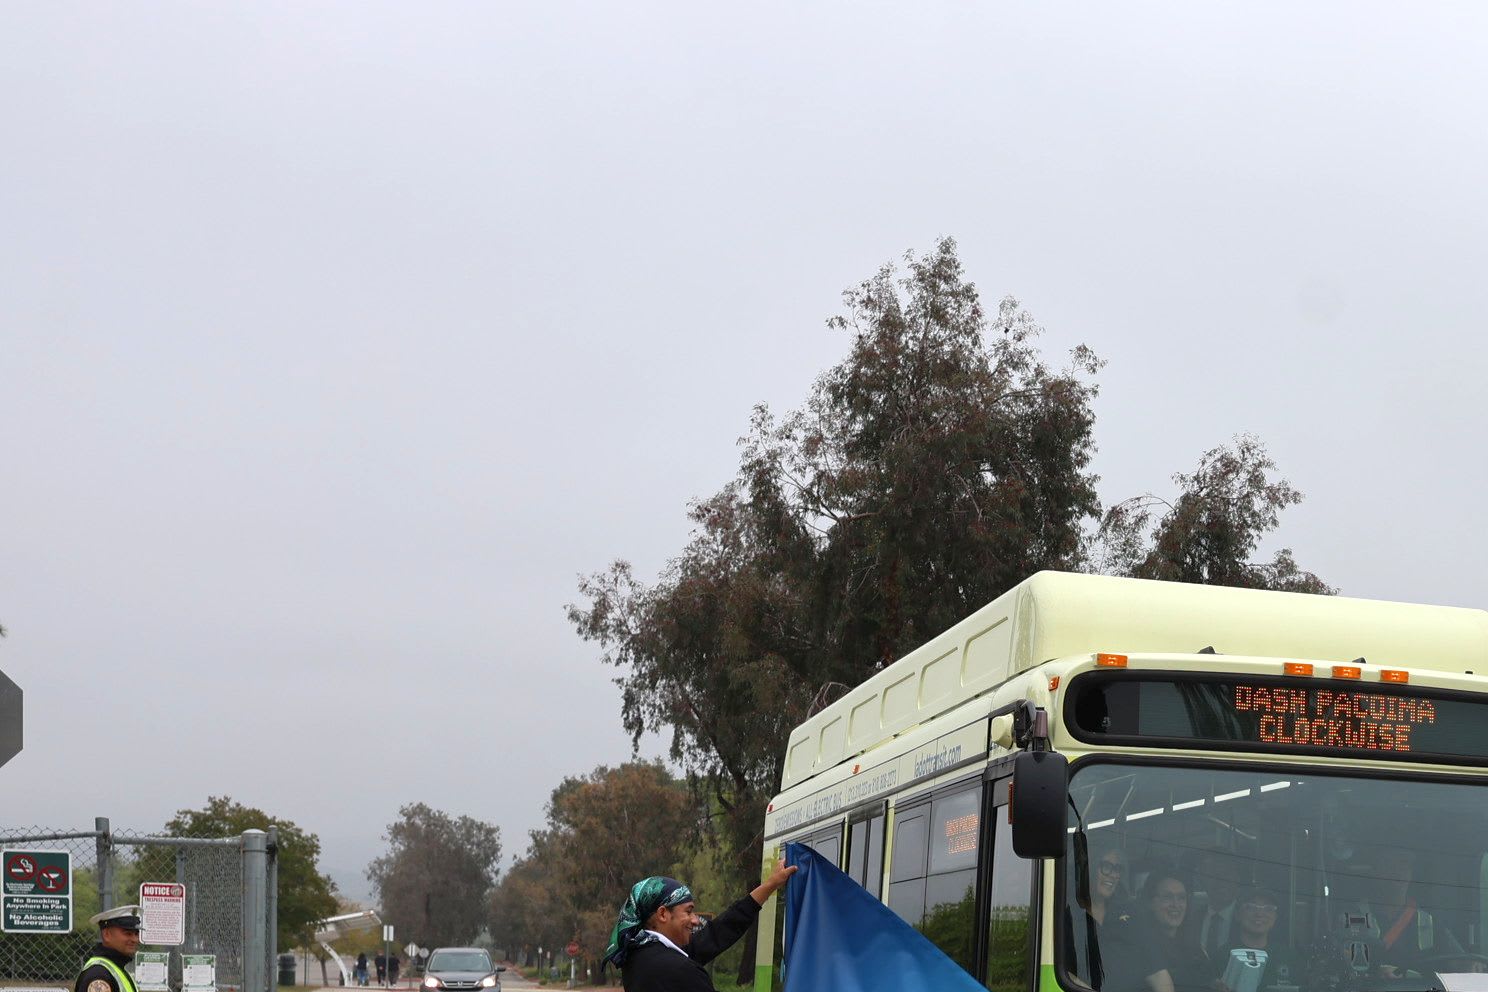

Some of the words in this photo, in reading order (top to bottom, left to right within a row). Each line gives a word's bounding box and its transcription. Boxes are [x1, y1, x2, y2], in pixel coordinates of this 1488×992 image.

[1236, 686, 1306, 715] DASH
[1316, 689, 1435, 724] PACOIMA
[1260, 714, 1411, 751] CLOCKWISE
[144, 886, 170, 896] NOTICE
